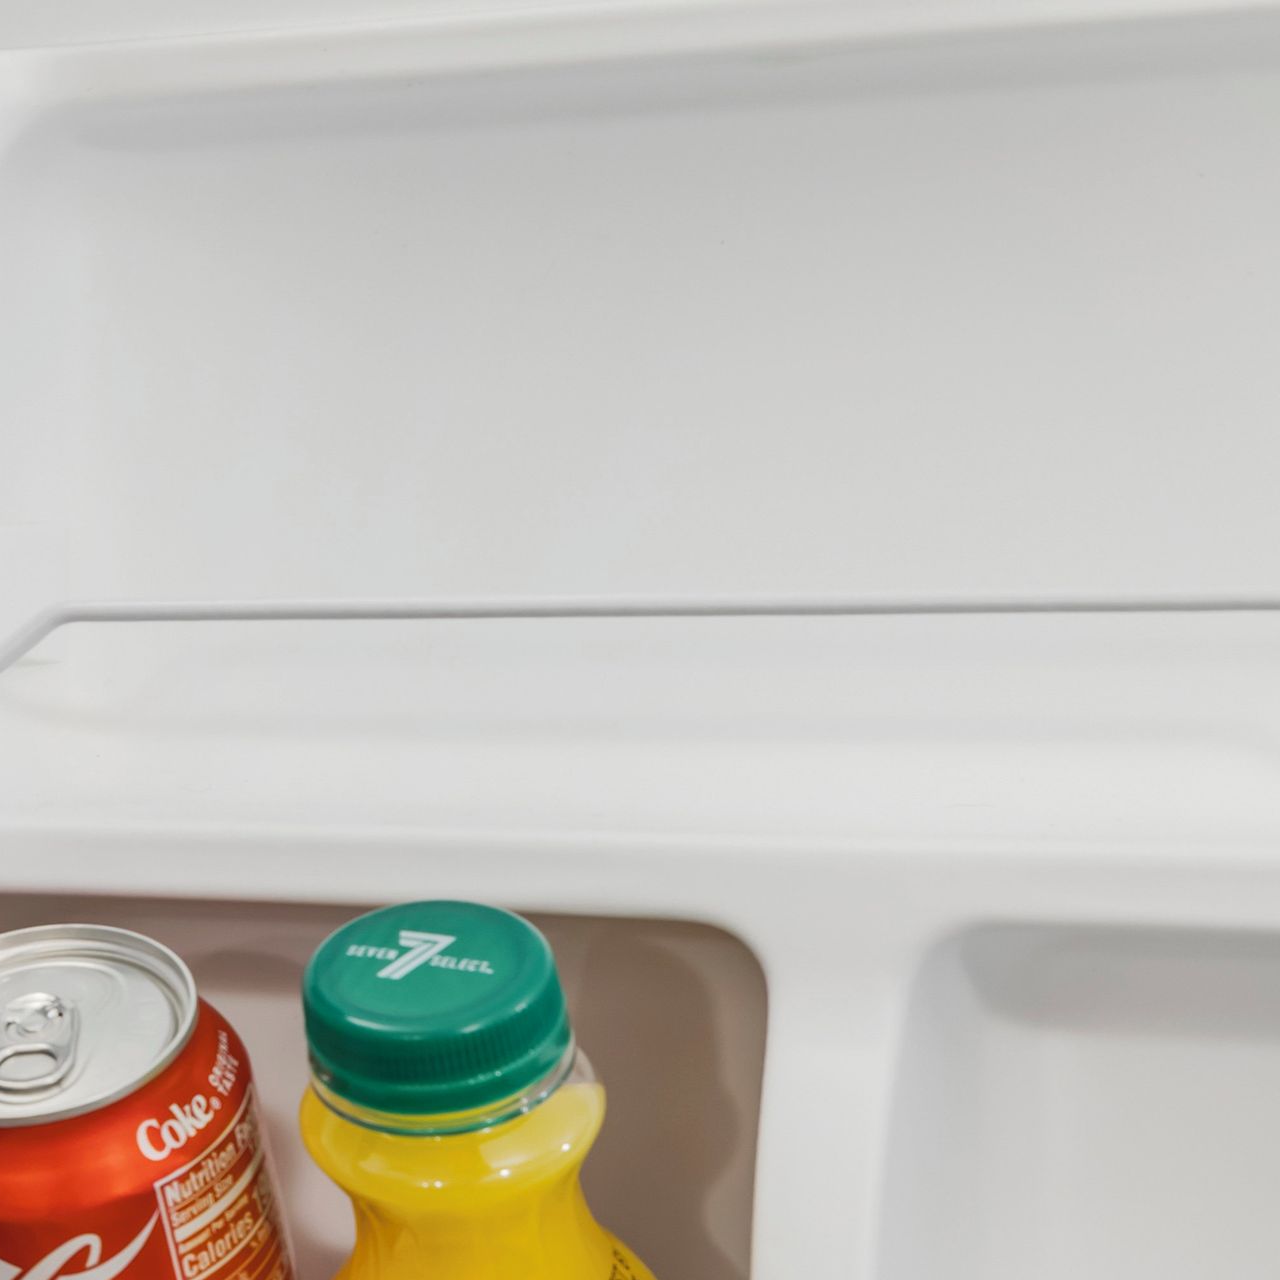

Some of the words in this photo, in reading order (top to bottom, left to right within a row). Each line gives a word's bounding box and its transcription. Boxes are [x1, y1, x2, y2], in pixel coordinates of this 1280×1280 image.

[376, 929, 458, 980] 7
[136, 1094, 214, 1162] Coke
[163, 1142, 242, 1208] Nutrition
[182, 1211, 254, 1278] Calories
